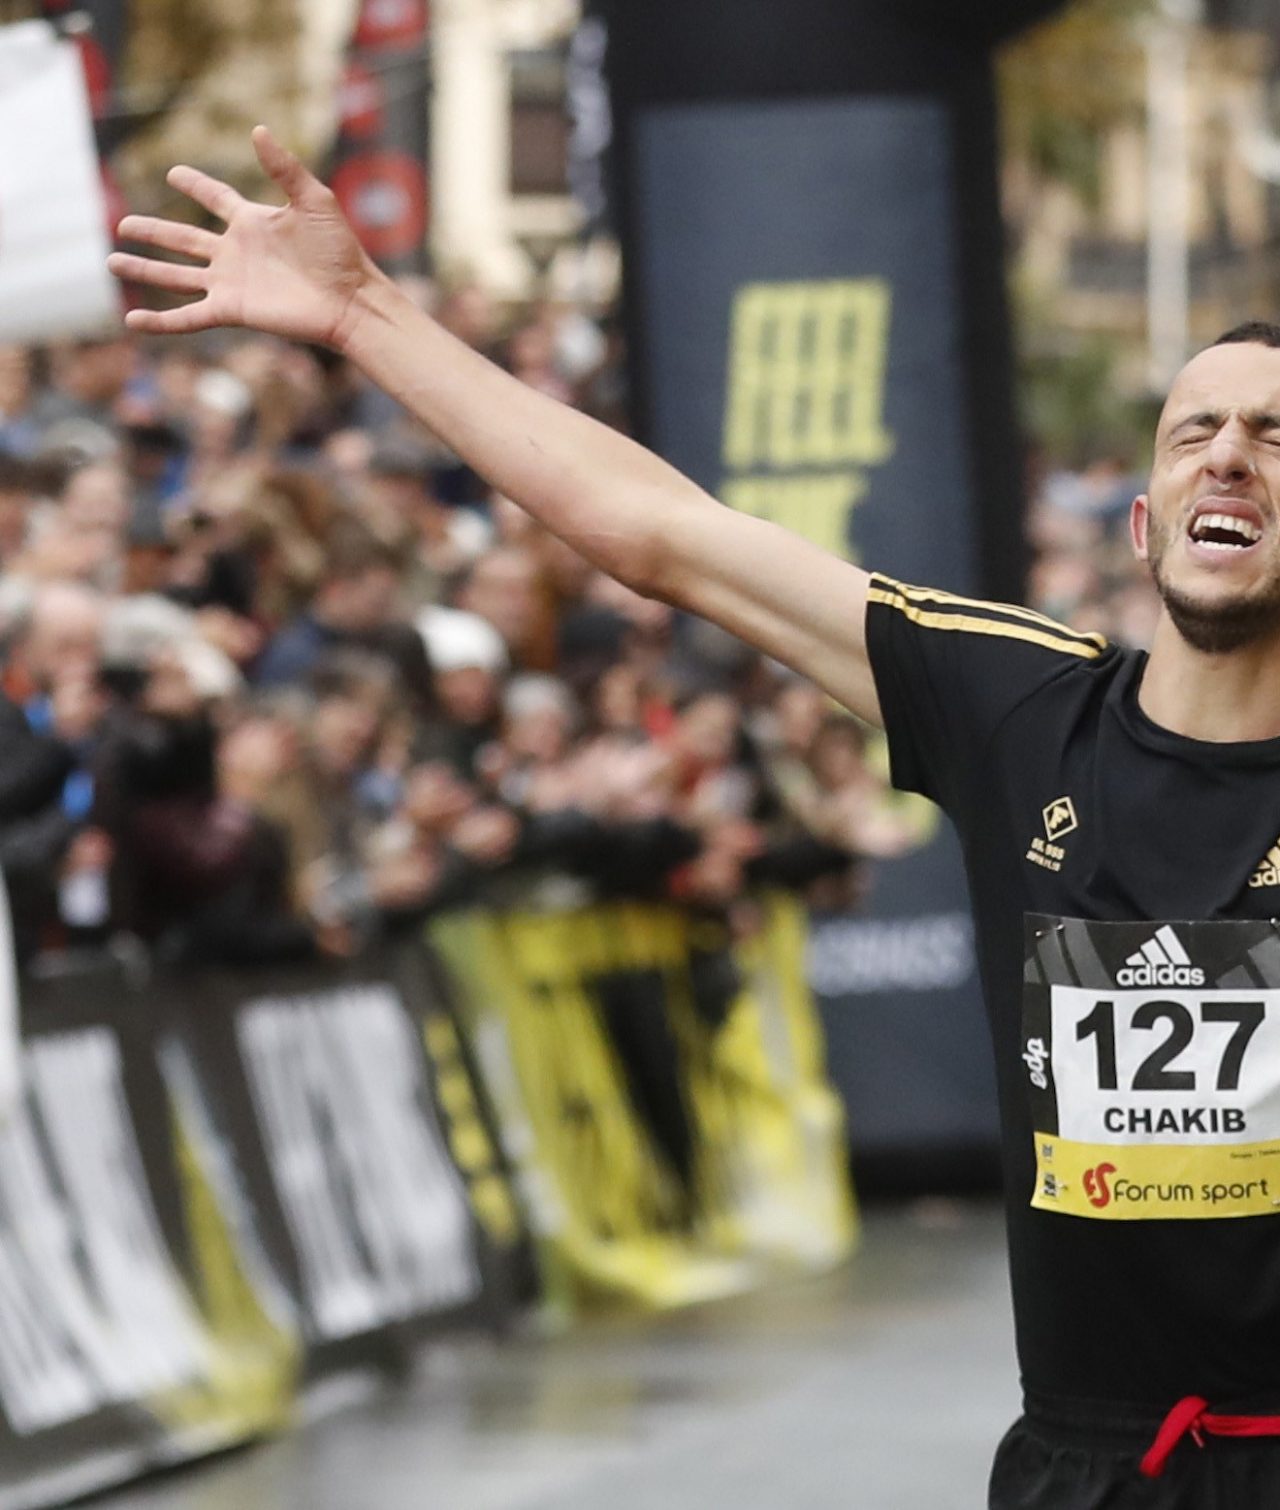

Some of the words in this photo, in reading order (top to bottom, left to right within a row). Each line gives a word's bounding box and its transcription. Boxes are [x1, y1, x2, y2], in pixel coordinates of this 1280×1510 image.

[1116, 961, 1206, 987] adidas
[1075, 1000, 1267, 1092] 127
[1103, 1107, 1247, 1135] CHAKIB
[1201, 1178, 1268, 1205] sport
